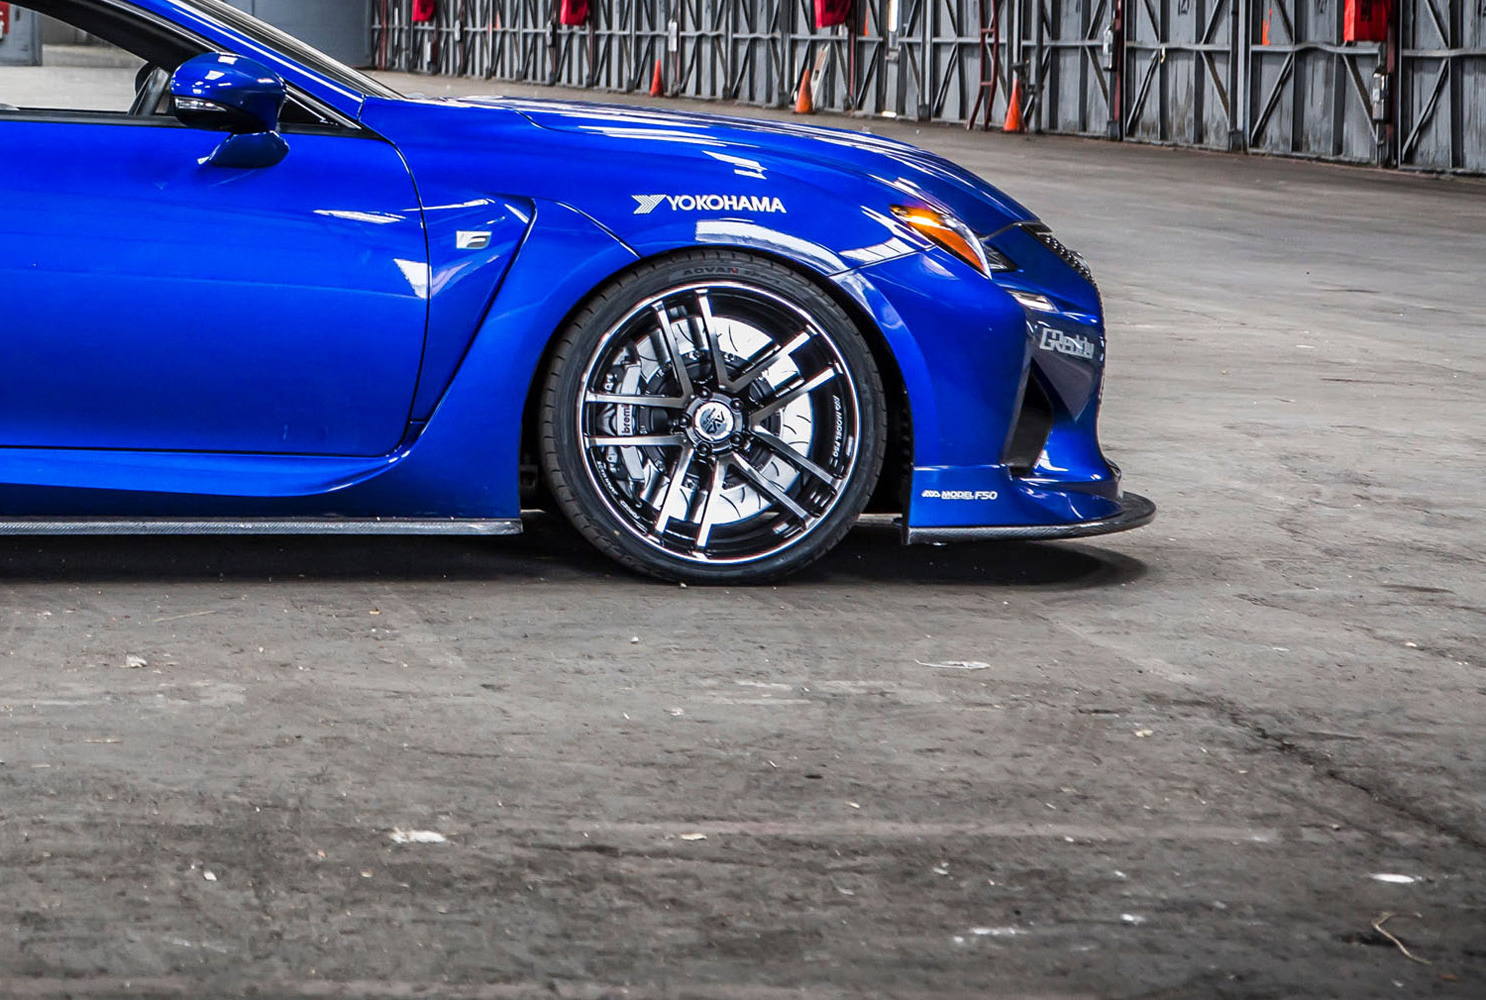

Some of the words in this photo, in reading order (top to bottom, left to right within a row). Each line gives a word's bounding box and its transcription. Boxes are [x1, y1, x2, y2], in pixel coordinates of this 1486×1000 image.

[666, 195, 787, 214] YOKOHAMA
[621, 404, 631, 434] brem
[835, 411, 843, 441] MODEL
[941, 490, 974, 500] MODEL
[974, 490, 998, 500] F50
